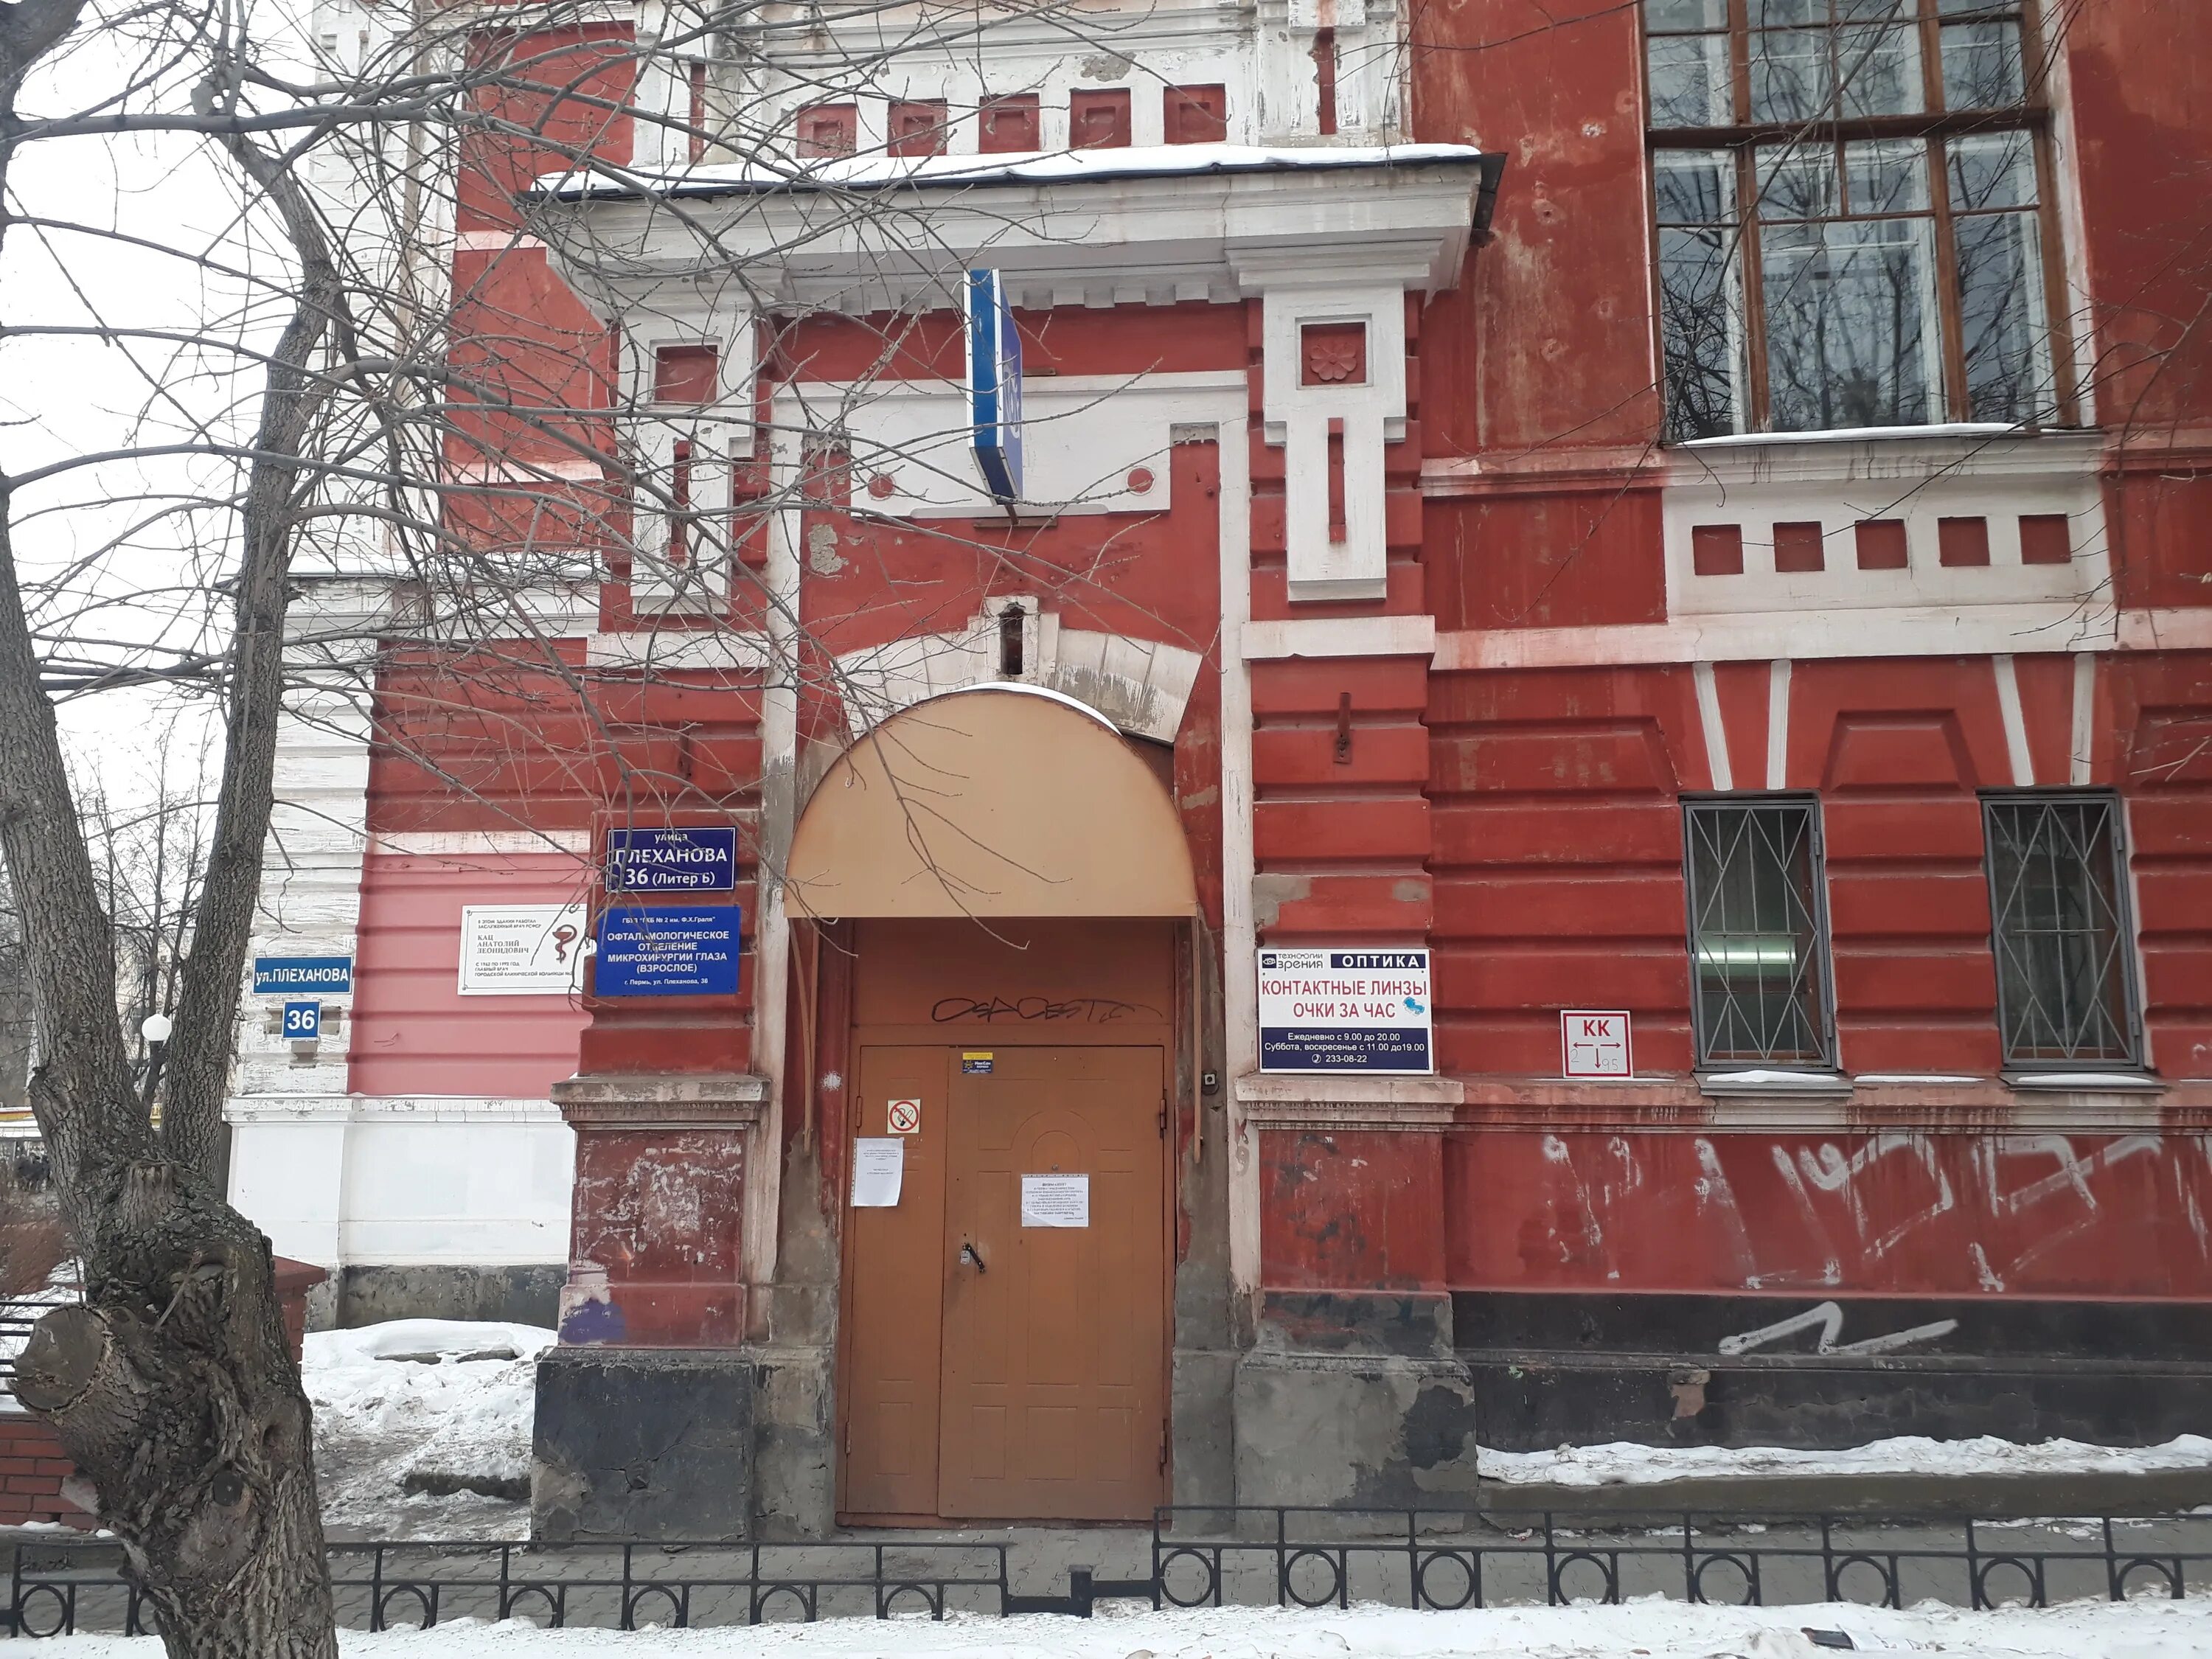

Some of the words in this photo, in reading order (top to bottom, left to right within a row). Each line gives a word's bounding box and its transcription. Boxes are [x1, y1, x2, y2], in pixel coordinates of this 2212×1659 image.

[655, 833, 688, 844] улица
[616, 848, 728, 863] ПЛЕХАНОВА
[625, 868, 649, 885] 36
[653, 872, 698, 886] (Литер
[607, 931, 729, 941] ОФТАЛЬМОЛОГИЧЕСКОЕ
[608, 953, 693, 962] МИКРОХИРУРГИИ
[695, 953, 728, 961] ГЛАЗА
[1342, 955, 1420, 967] ОПТИКА
[636, 964, 698, 974] (ВЗРОСЛОЕ)
[1278, 960, 1323, 972] зрения
[256, 968, 349, 986] ул.ПЛЕХАНОВА
[1262, 980, 1366, 995] КОНТАКТНЫЕ
[1370, 980, 1427, 995] ЛИНЗЫ
[1293, 1003, 1335, 1018] ОЧКИ
[1339, 1003, 1359, 1018] ЗА
[1364, 1003, 1396, 1018] ЧАС
[287, 1009, 316, 1030] 36
[1288, 1032, 1335, 1041] Ежедневно
[1343, 1032, 1362, 1041] 9.00
[1364, 1034, 1375, 1043] до
[1377, 1033, 1400, 1041] 20.00
[1265, 1043, 1302, 1052] Суббота,
[1304, 1044, 1357, 1053] воскресенье
[1366, 1043, 1389, 1051] 11.00
[1325, 1054, 1368, 1063] 233-08-22
